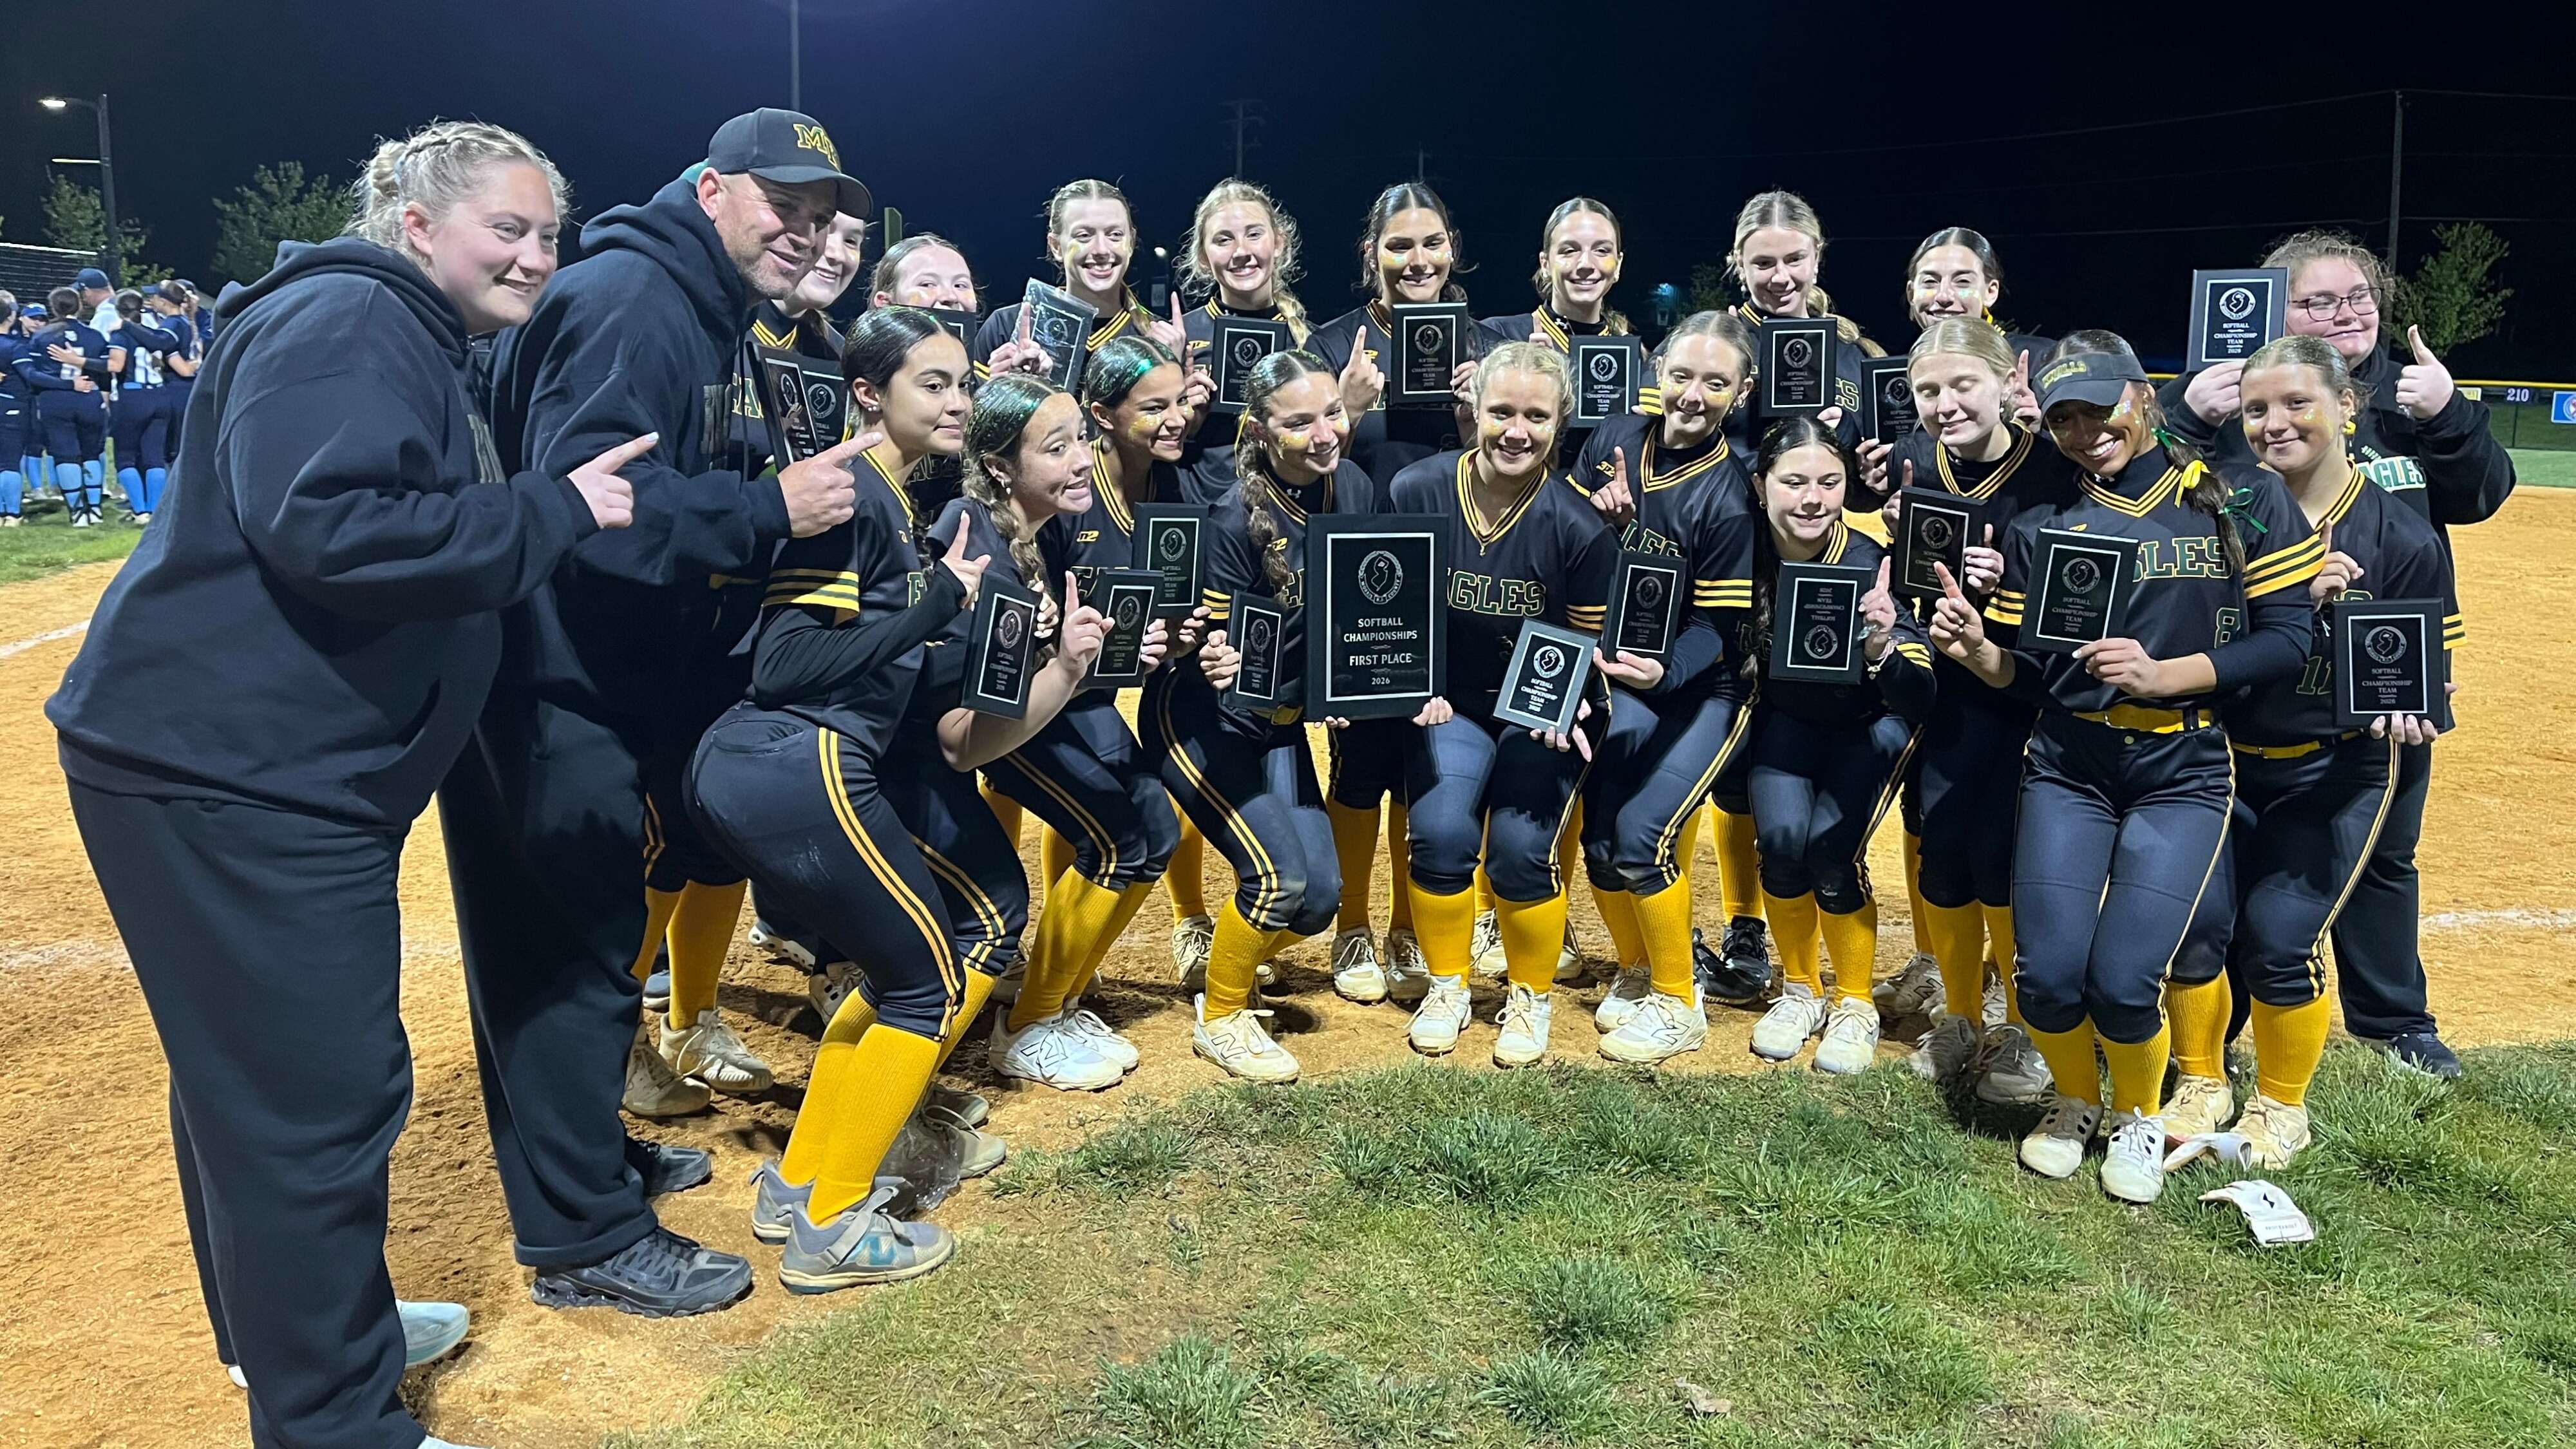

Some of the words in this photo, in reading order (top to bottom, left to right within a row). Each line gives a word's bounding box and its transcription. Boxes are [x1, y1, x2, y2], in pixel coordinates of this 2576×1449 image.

[2506, 388, 2530, 402] 210
[2062, 597, 2092, 605] SOFTBALL
[2051, 607, 2099, 618] CHAMPIONSHIP
[1358, 617, 1404, 627] SOFTBALL
[1343, 630, 1417, 642] CHAMPIONSHIPS
[1349, 654, 1379, 666] FIRST
[1381, 653, 1412, 664] PLACE
